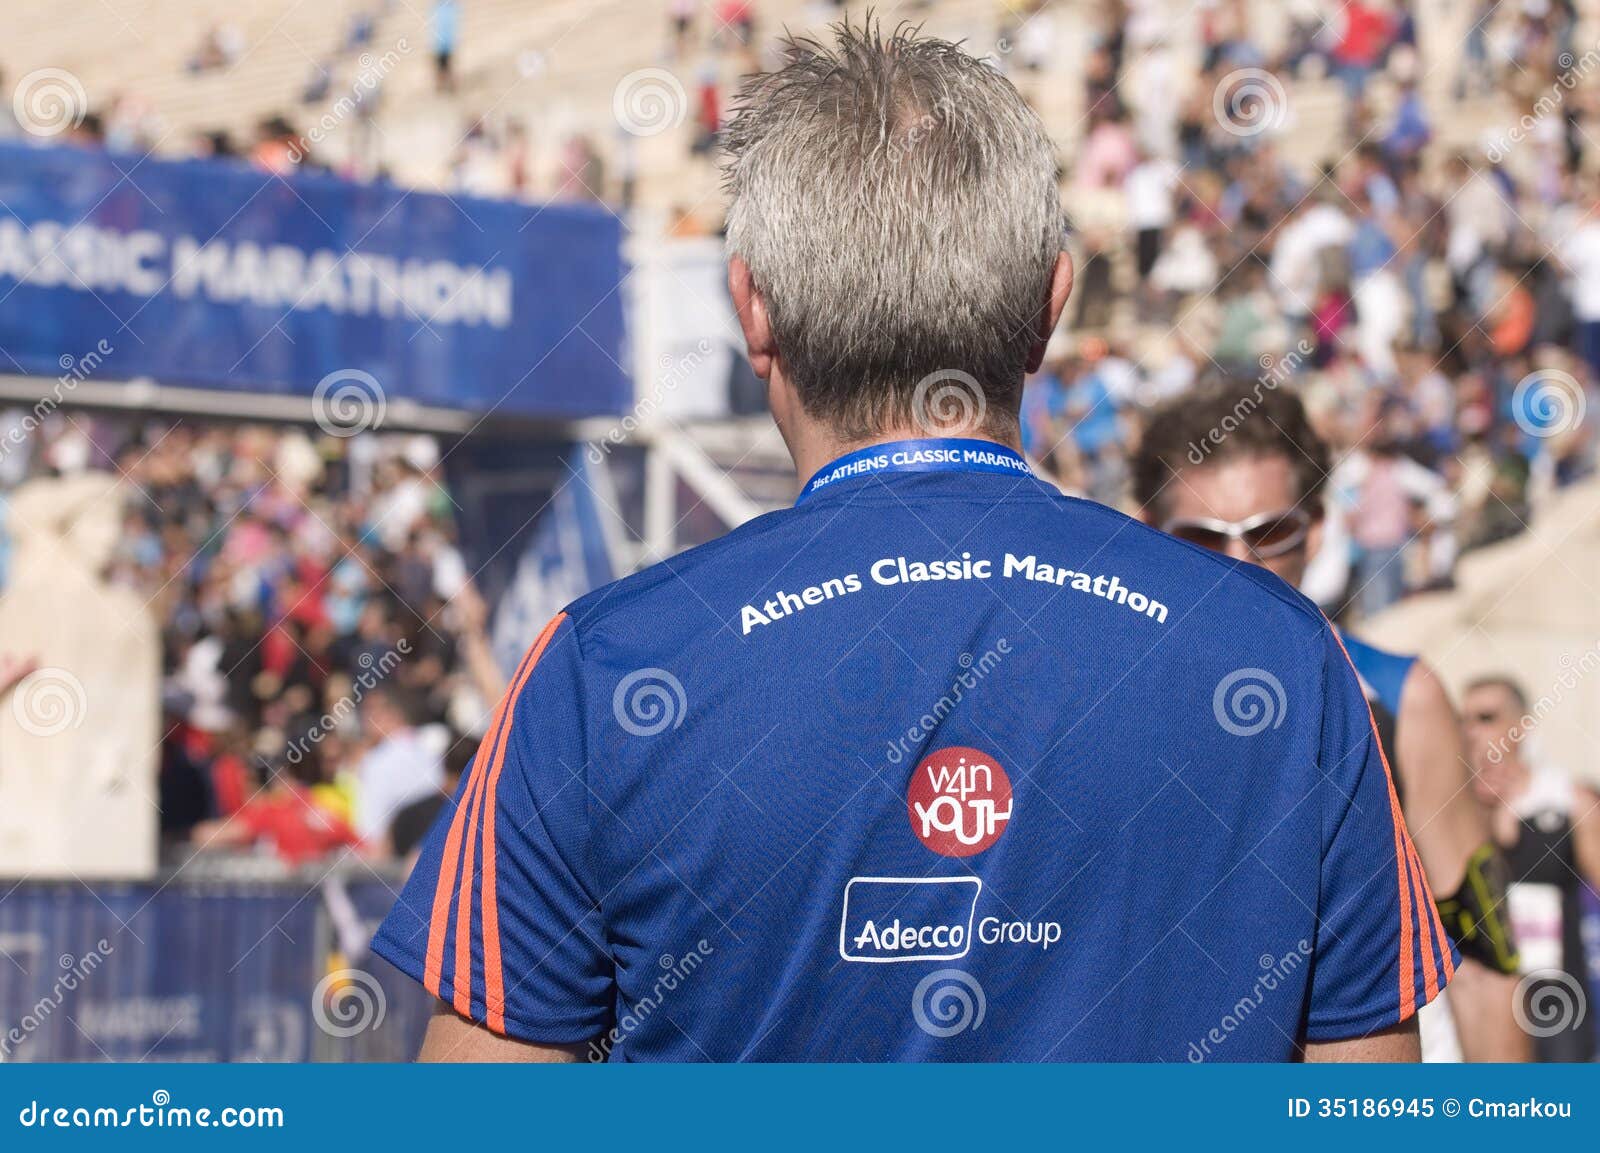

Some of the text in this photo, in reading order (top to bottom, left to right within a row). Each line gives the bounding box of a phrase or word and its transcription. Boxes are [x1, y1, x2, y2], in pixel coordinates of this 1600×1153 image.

[172, 235, 513, 328] MARATHON
[830, 455, 889, 482] ATHENS
[892, 449, 961, 466] CLASSIC
[740, 551, 1169, 636] Athens Classic Marathon
[914, 796, 1013, 845] YOUTH
[854, 917, 1062, 950] Adecco Group
